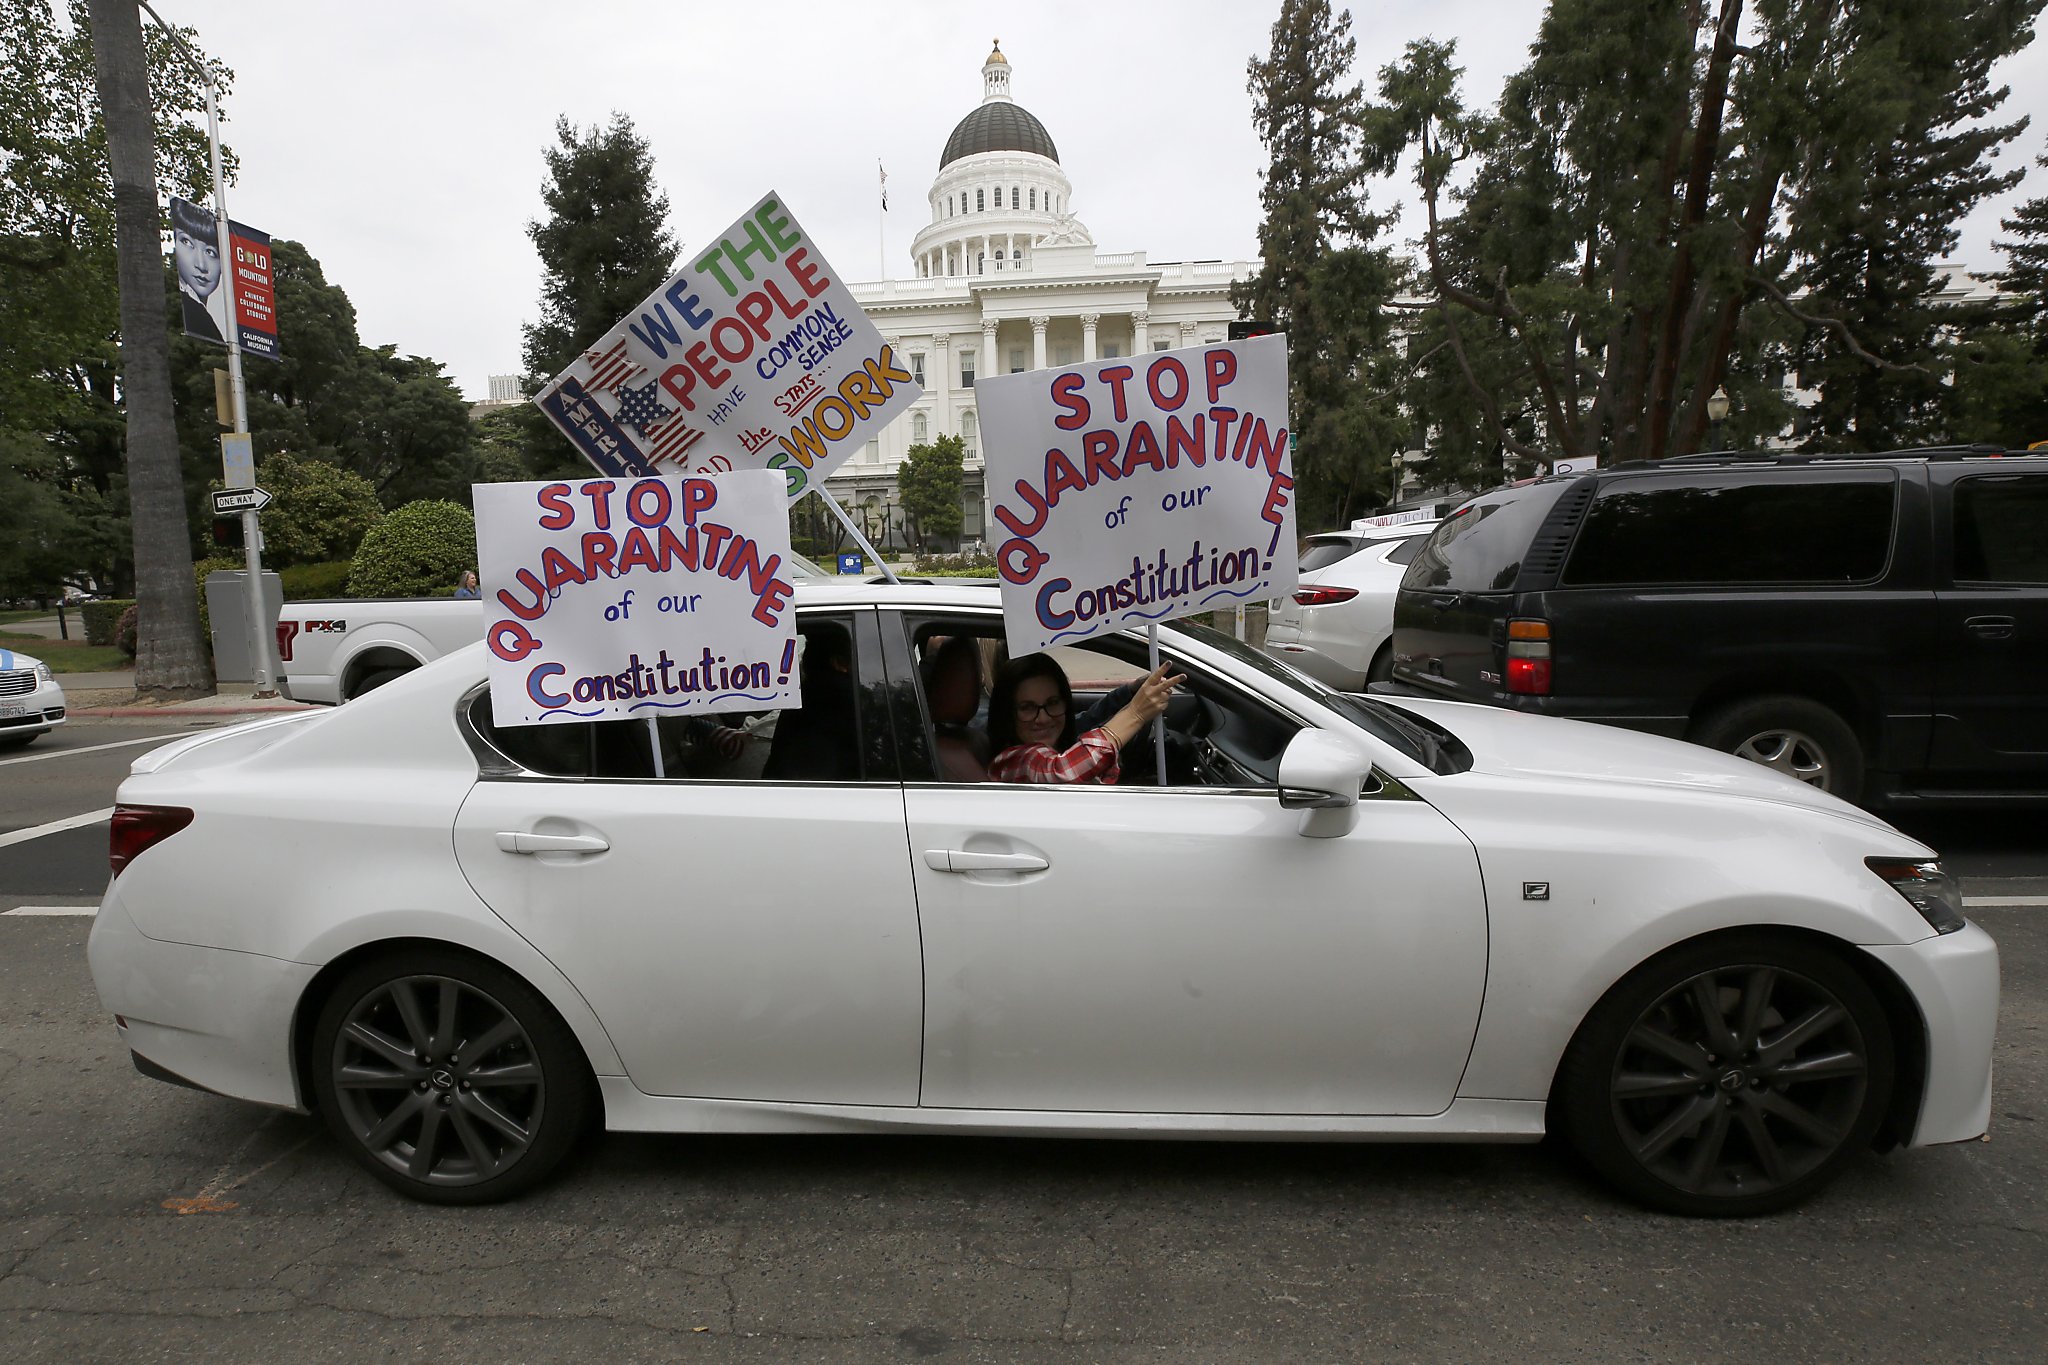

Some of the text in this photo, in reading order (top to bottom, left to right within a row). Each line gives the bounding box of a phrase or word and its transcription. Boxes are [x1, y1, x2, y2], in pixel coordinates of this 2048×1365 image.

[238, 267, 268, 285] MOUNTAIN
[629, 199, 801, 360] WE THE
[242, 332, 274, 346] CALIFORNIA
[247, 341, 271, 353] MUSEUM
[659, 247, 830, 412] PEOPLE
[798, 318, 853, 370] SENSE
[707, 301, 837, 426] HAVE COMMON
[1050, 348, 1237, 431] STOP
[560, 392, 641, 477] AMERIC
[737, 427, 772, 451] the
[219, 494, 253, 507] ONE WAY
[537, 478, 718, 531] STOP
[994, 406, 1294, 585] QUARANTINE
[1105, 485, 1211, 529] of our
[487, 522, 794, 662] QUARANTINE
[604, 590, 702, 622] of our
[305, 620, 346, 632] FX4
